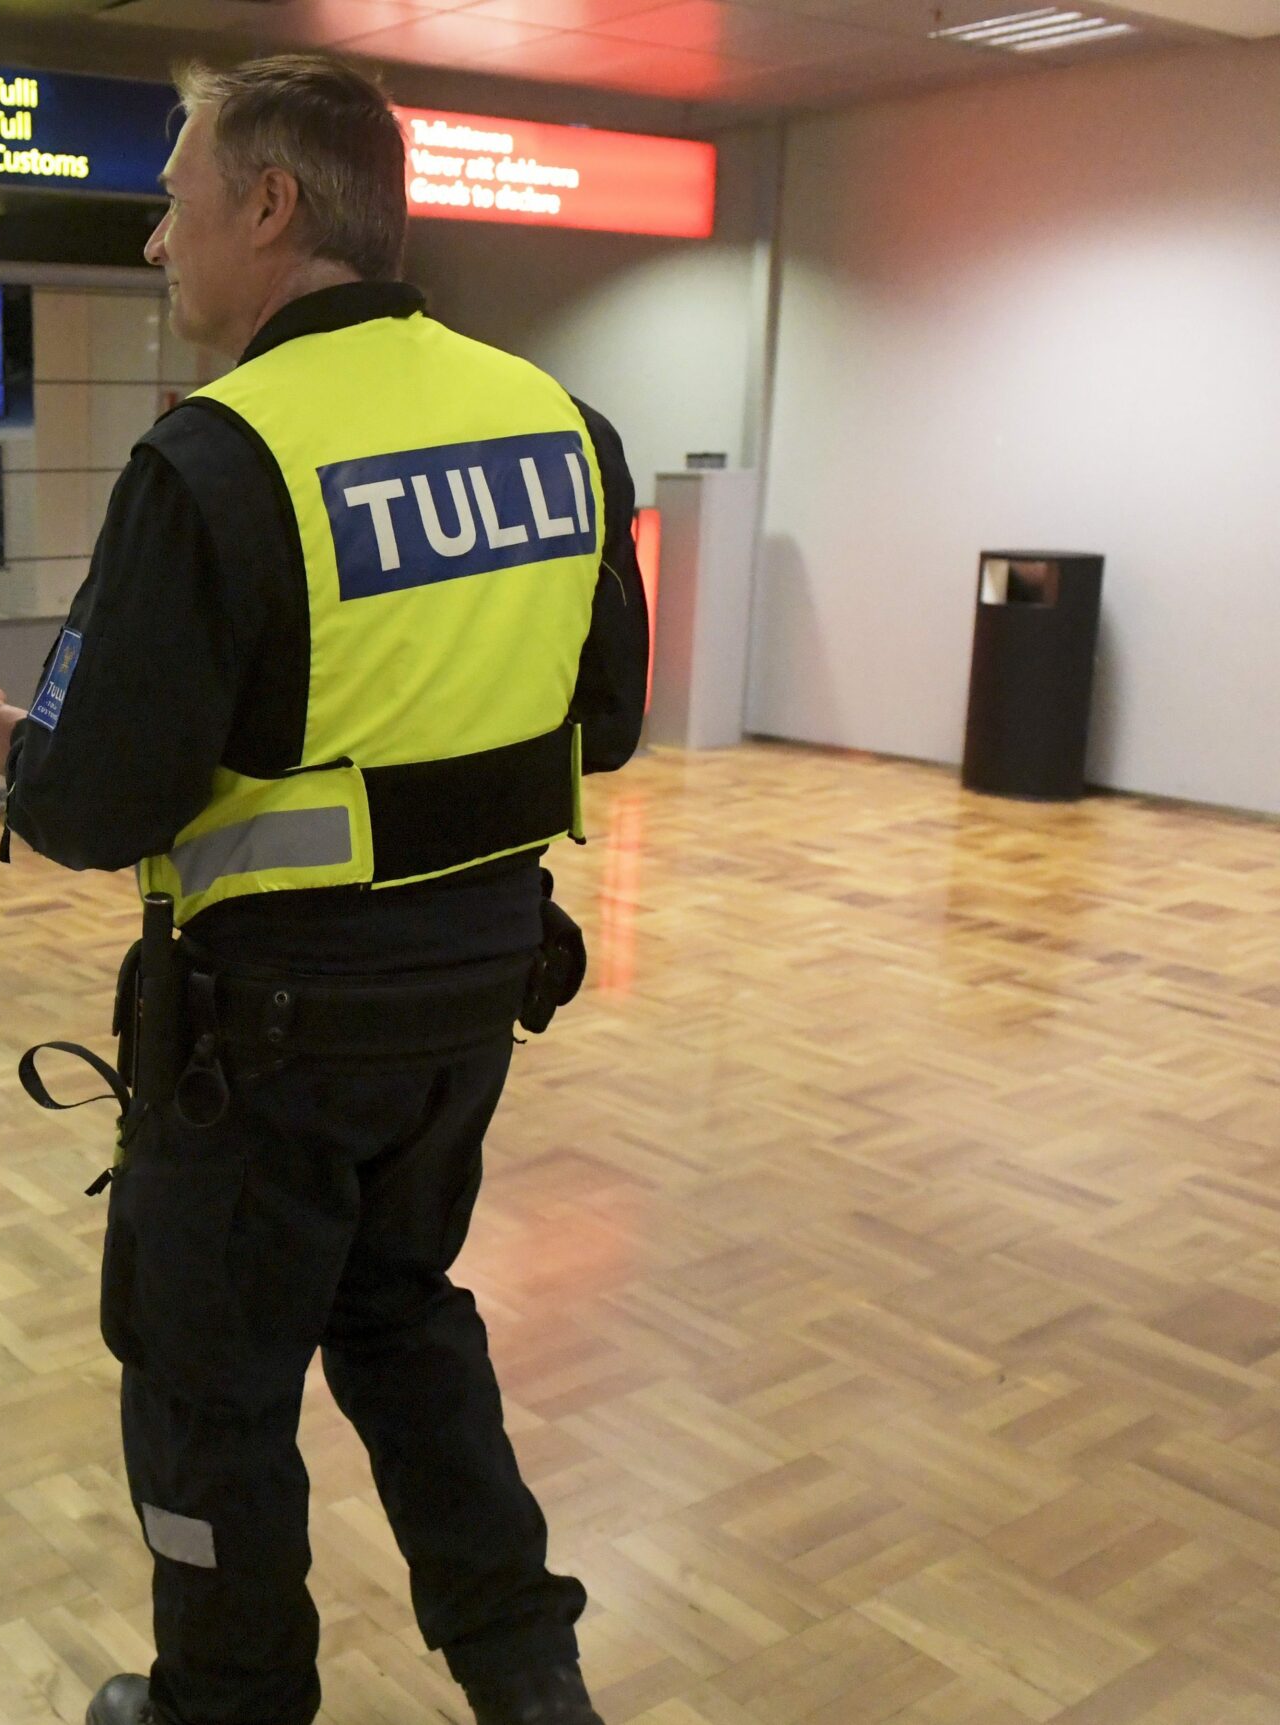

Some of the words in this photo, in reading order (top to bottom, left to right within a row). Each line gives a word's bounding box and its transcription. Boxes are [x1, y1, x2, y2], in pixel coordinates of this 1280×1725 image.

[409, 176, 471, 207] Goods
[471, 184, 496, 209] to
[495, 184, 561, 214] declare
[343, 452, 590, 573] TULLI
